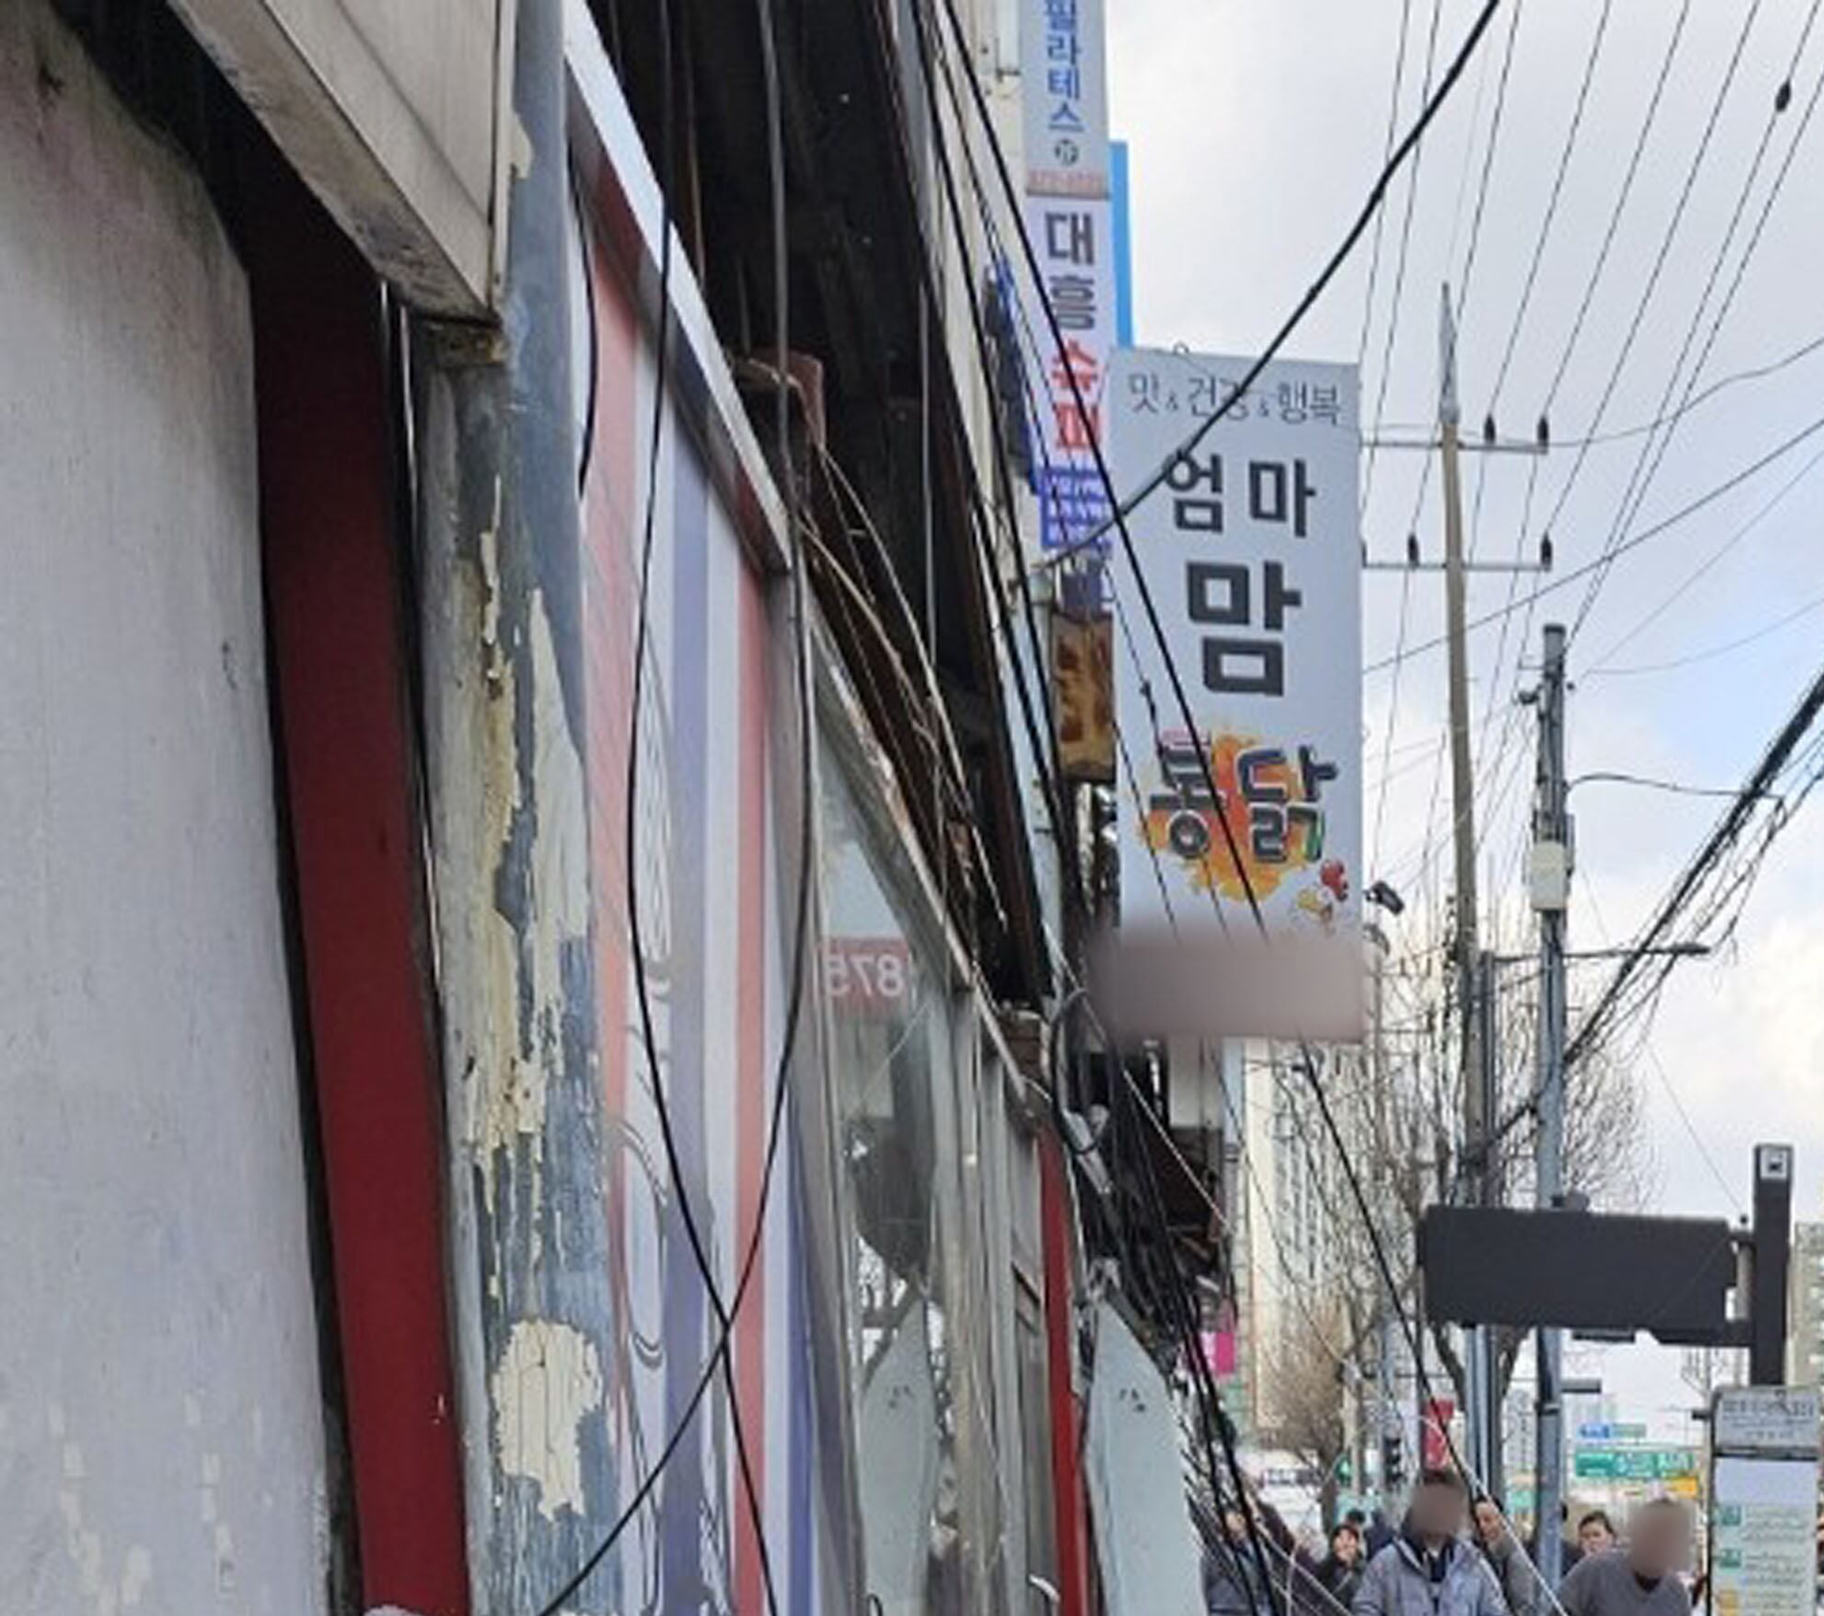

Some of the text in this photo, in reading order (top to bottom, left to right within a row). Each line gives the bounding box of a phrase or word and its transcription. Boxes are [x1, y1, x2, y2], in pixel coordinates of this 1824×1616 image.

[1128, 373, 1160, 415] 맛
[1277, 381, 1340, 427] 행복
[1161, 453, 1317, 539] 엄마
[1186, 559, 1302, 697] 맘
